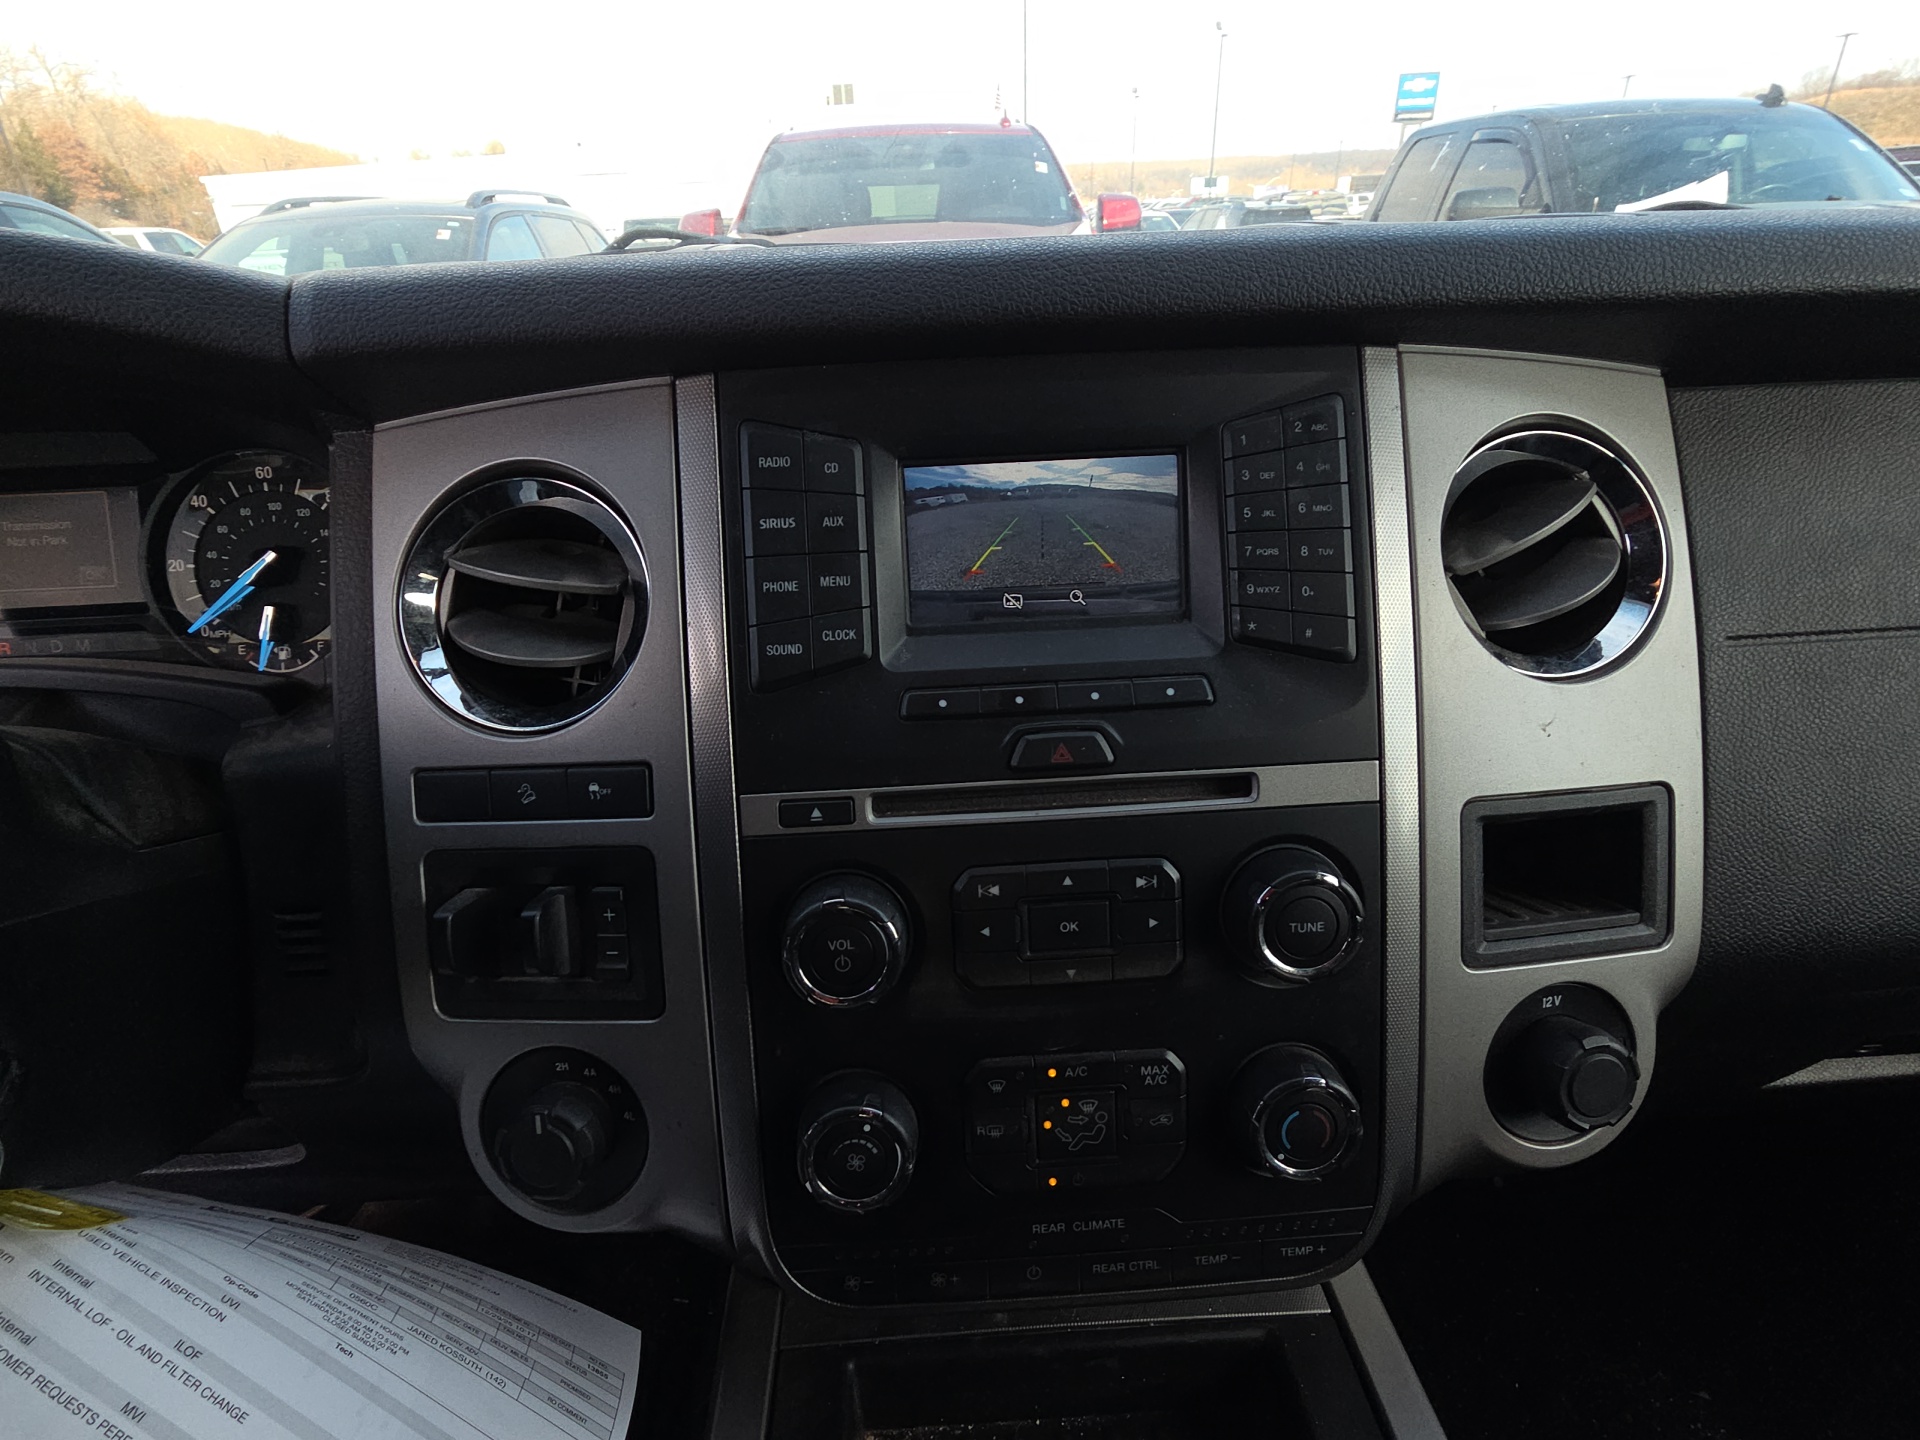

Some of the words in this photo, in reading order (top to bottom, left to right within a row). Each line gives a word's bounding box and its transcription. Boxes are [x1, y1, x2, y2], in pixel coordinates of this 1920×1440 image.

[1294, 421, 1302, 432] 2
[1311, 423, 1328, 431] ABC
[1240, 435, 1246, 446] 1
[758, 456, 791, 468] RADIO
[824, 462, 838, 474] CD
[1296, 462, 1304, 472] 4
[255, 466, 272, 479] 60
[1241, 470, 1250, 480] 3
[1260, 471, 1276, 479] DEF
[190, 495, 208, 508] 40
[267, 502, 282, 511] 100
[240, 508, 251, 516] 80
[296, 508, 311, 517] 120
[1243, 507, 1252, 518] 5
[1261, 510, 1276, 518] JKL
[1298, 503, 1306, 513] 6
[1313, 504, 1333, 512] MNO
[759, 517, 796, 529] SIRIUS
[822, 516, 844, 527] AUX
[217, 525, 229, 534] 60
[206, 551, 217, 559] 40
[1244, 546, 1252, 557] 7
[1256, 548, 1279, 556] PQRS
[1300, 546, 1309, 556] 8
[1318, 548, 1334, 556] TUV
[168, 559, 184, 572] 20
[210, 579, 221, 588] 20
[763, 581, 799, 592] PHONE
[820, 576, 851, 587] MENU
[1247, 584, 1254, 594] 9
[1256, 586, 1280, 594] WXYZ
[200, 624, 210, 637] 0
[209, 629, 231, 639] MPH
[822, 629, 856, 641] CLOCK
[238, 645, 247, 655] E
[317, 642, 324, 652] F
[766, 644, 803, 656] SOUND
[1060, 921, 1079, 934] OK
[1289, 922, 1325, 933] TUNE
[828, 939, 855, 951] VOL
[1542, 995, 1562, 1009] 12V
[555, 1062, 569, 1071] 2H
[1065, 1066, 1088, 1077] A/C
[1140, 1065, 1169, 1076] MAX
[1144, 1075, 1168, 1085] A/C
[1032, 1222, 1065, 1234] REAR
[1073, 1218, 1125, 1232] CLIMATE
[96, 1226, 138, 1249] Internal
[1280, 1246, 1314, 1257] TEMP
[1194, 1254, 1228, 1265] TEMP
[1093, 1262, 1125, 1273] REAR
[1129, 1260, 1161, 1271] CTRL
[52, 1258, 96, 1289] Internal
[78, 1229, 112, 1251] USED
[112, 1247, 162, 1281] VEHICLE
[159, 1277, 227, 1323] INSPECTION
[223, 1275, 259, 1299] Op-Code
[220, 1294, 241, 1310] UVI
[301, 1281, 332, 1300] SERVICE
[332, 1298, 379, 1326] DEPARTMENT
[379, 1323, 405, 1341] HOURS
[285, 1281, 317, 1300] MONDAY
[321, 1300, 347, 1317] FRIDAY
[362, 1324, 374, 1334] AM
[374, 1330, 384, 1340] TO
[398, 1346, 410, 1356] PM
[296, 1293, 334, 1317] SATURDAY
[349, 1324, 361, 1334] AM
[361, 1330, 371, 1340] TO
[385, 1346, 398, 1356] PM
[322, 1314, 352, 1335] CLOSED
[351, 1332, 381, 1352] SUNDAY
[28, 1269, 85, 1313] INTERNAL
[84, 1307, 113, 1327] LOF
[116, 1329, 136, 1348] OIL
[135, 1343, 163, 1364] AND
[160, 1359, 203, 1392] FILTER
[200, 1386, 250, 1425] CHANGE
[173, 1339, 203, 1360] ILOF
[335, 1342, 354, 1358] Tech
[406, 1325, 439, 1346] JARED
[438, 1344, 483, 1373] KOSSUTH
[485, 1370, 507, 1389] (142)
[31, 1374, 100, 1426] REQUESTS
[120, 1401, 147, 1424] MVI
